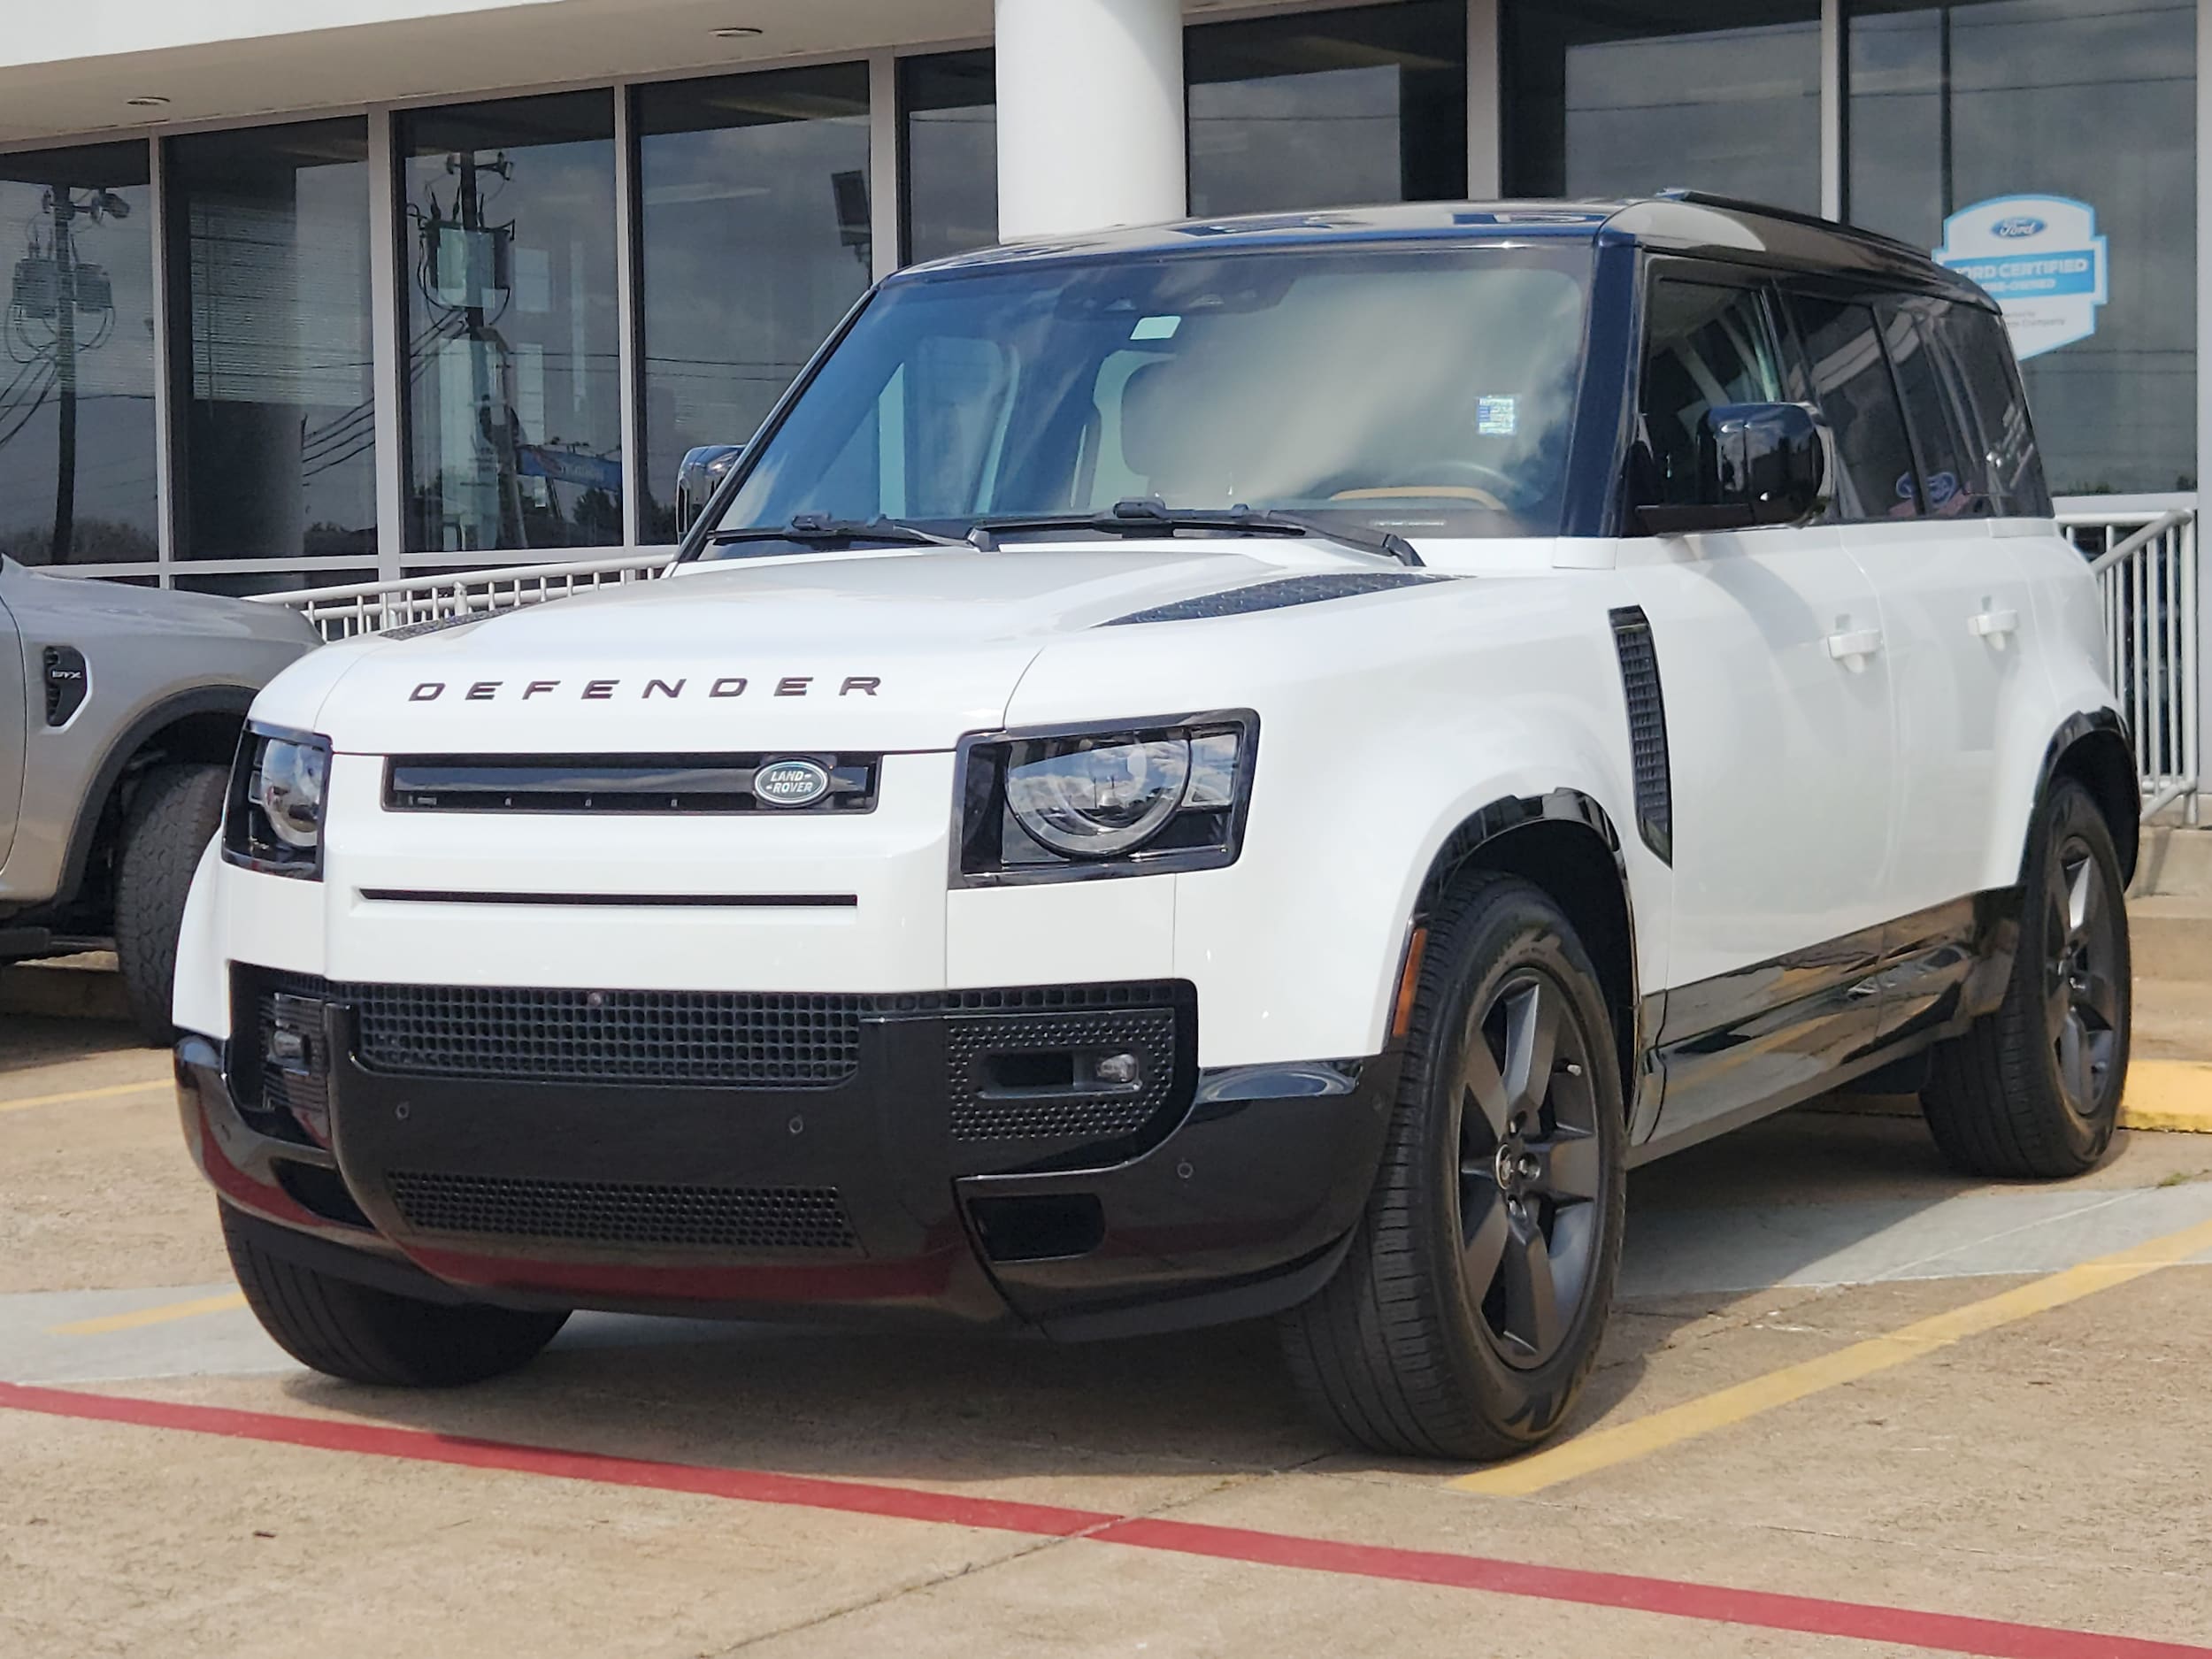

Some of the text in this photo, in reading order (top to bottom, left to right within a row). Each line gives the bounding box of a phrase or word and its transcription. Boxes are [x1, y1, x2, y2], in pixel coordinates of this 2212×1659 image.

[1999, 221, 2037, 236] Ford
[1955, 259, 2089, 280] ORD CERTIFIED
[408, 676, 882, 703] DEFENDER
